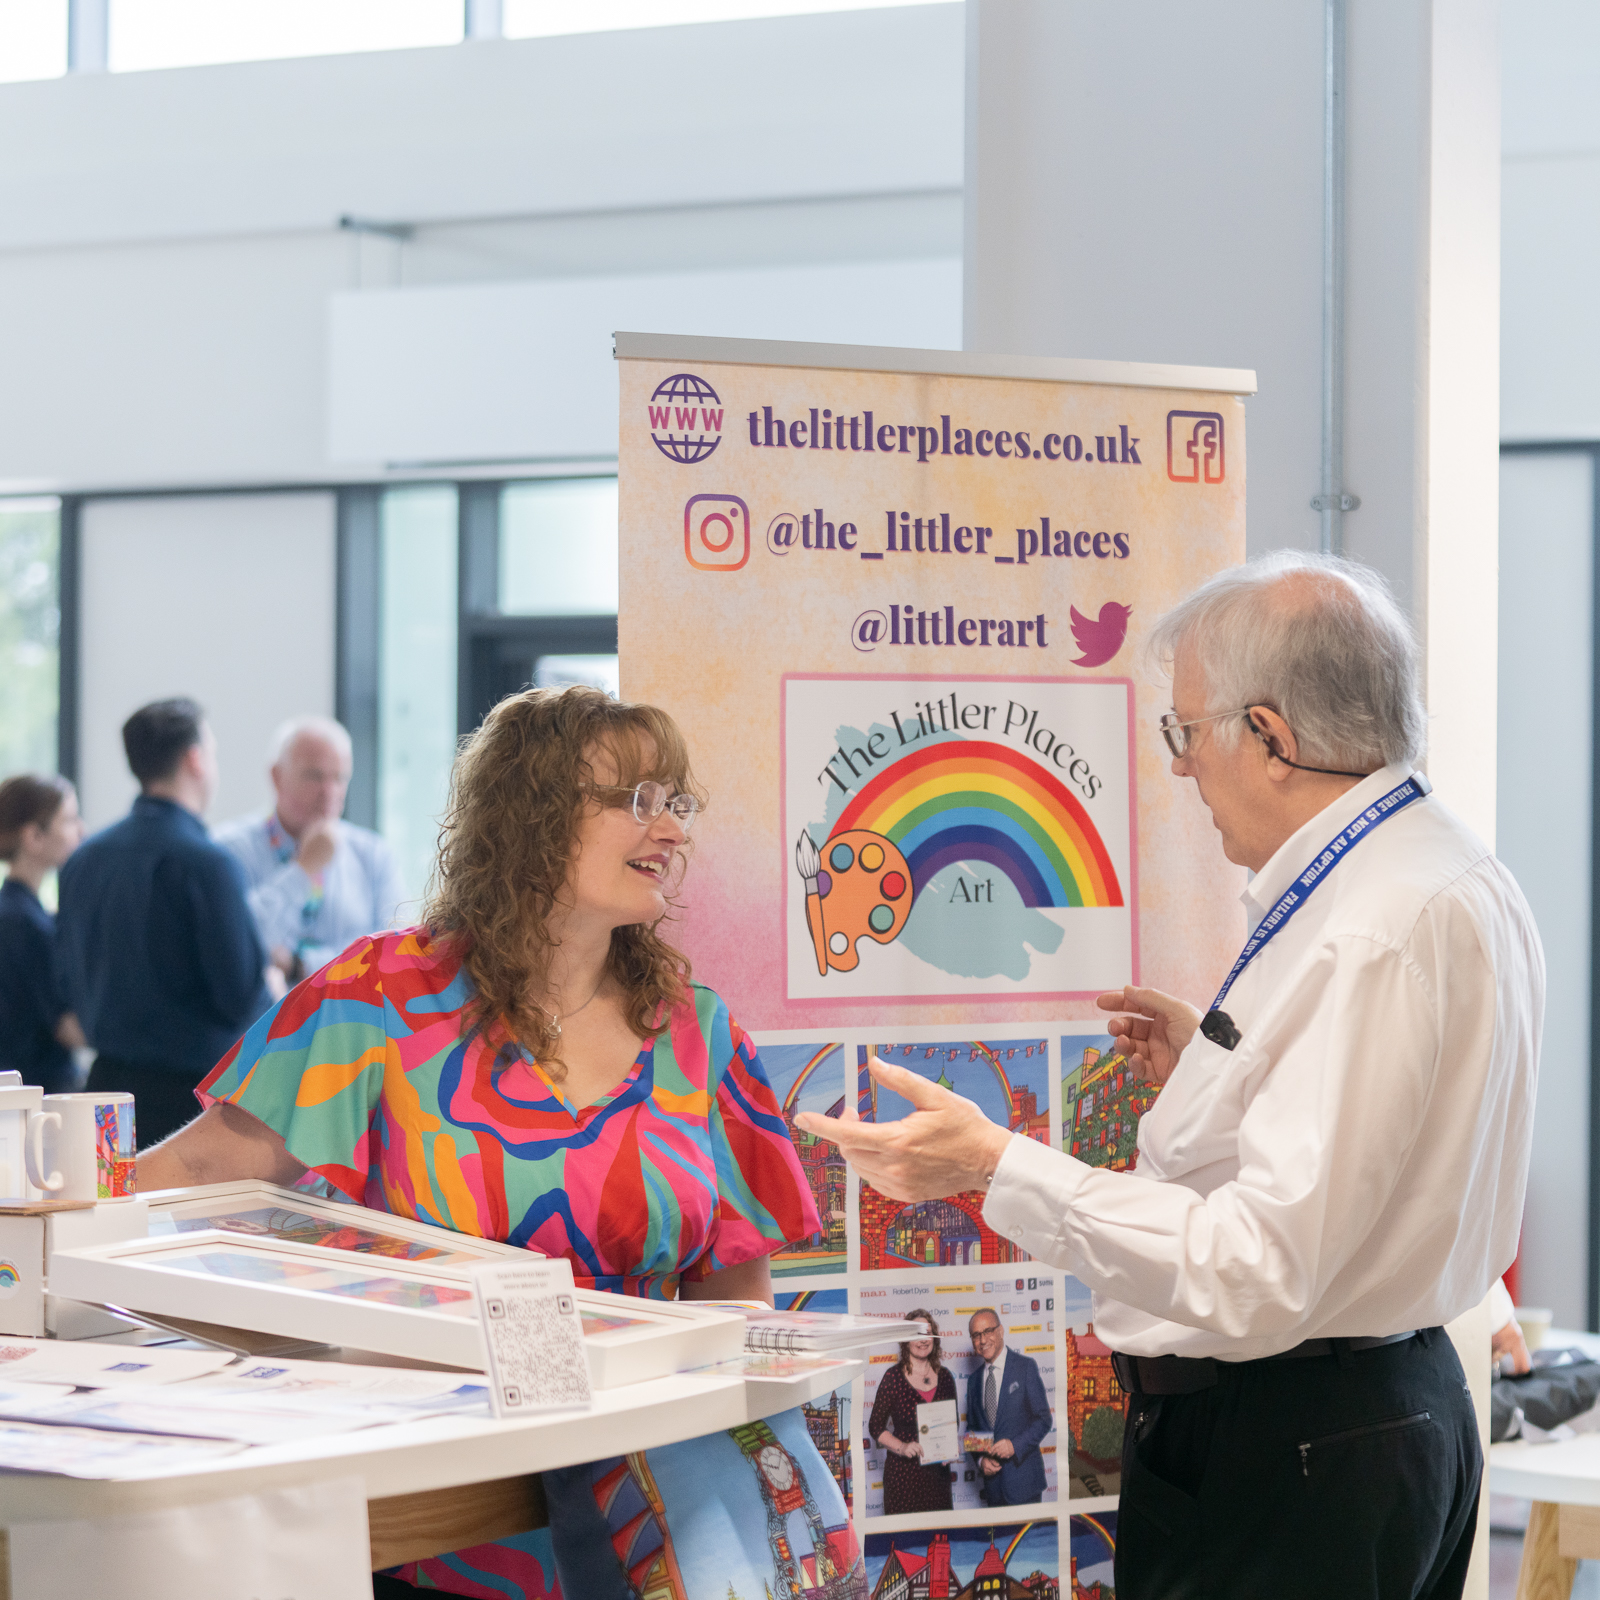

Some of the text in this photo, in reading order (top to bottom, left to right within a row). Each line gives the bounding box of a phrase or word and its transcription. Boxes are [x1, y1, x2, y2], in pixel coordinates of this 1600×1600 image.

[746, 406, 1142, 465] thelittlerplaces.co.uk
[767, 508, 1130, 565] @the_littler_places
[851, 605, 1048, 652] @littlerart
[817, 692, 1102, 799] The Littler Places
[1300, 783, 1415, 887] FAILURE IS NOT AN OPTION
[949, 876, 994, 903] Art
[1262, 891, 1299, 930] FAILURE
[1243, 939, 1260, 956] NOT
[1255, 928, 1269, 938] IS
[893, 1288, 913, 1296] Robert
[914, 1287, 929, 1295] Dyas
[934, 1308, 949, 1316] Dyas
[872, 1355, 895, 1363] DHL
